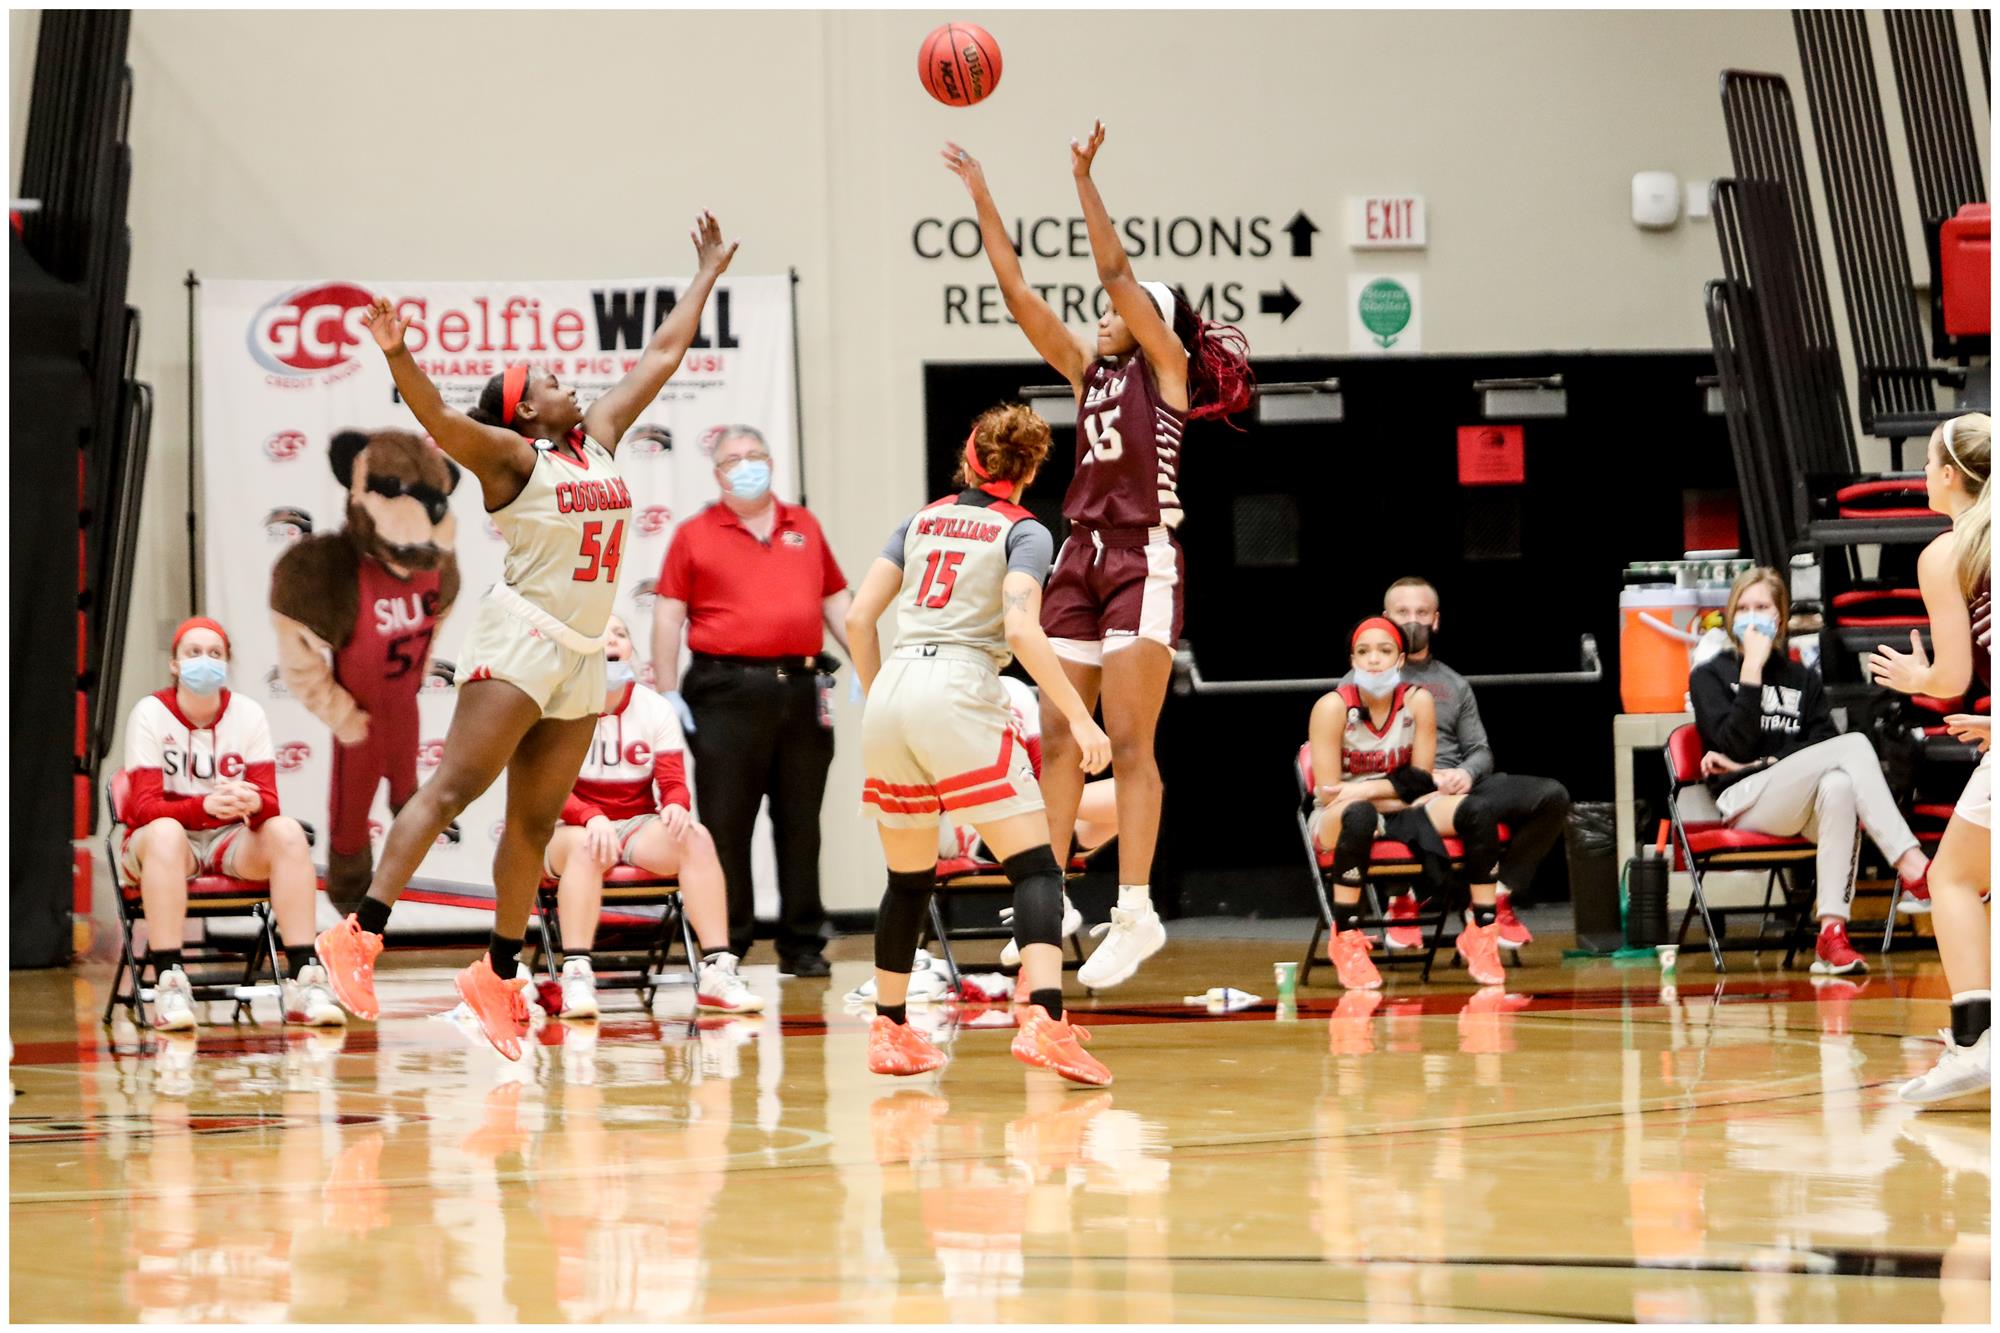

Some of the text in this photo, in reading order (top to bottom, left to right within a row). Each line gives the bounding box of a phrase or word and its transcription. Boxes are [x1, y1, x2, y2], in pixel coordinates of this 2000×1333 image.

[963, 43, 984, 99] Wilson
[913, 217, 1272, 259] COCESIONS
[1366, 199, 1414, 239] EXIT
[396, 296, 584, 353] Selfie
[945, 282, 1244, 323] RETRMS
[256, 304, 372, 359] GCS
[575, 358, 613, 374] PIC
[1081, 405, 1124, 464] 15
[572, 519, 624, 583] 54
[914, 549, 965, 609] 15
